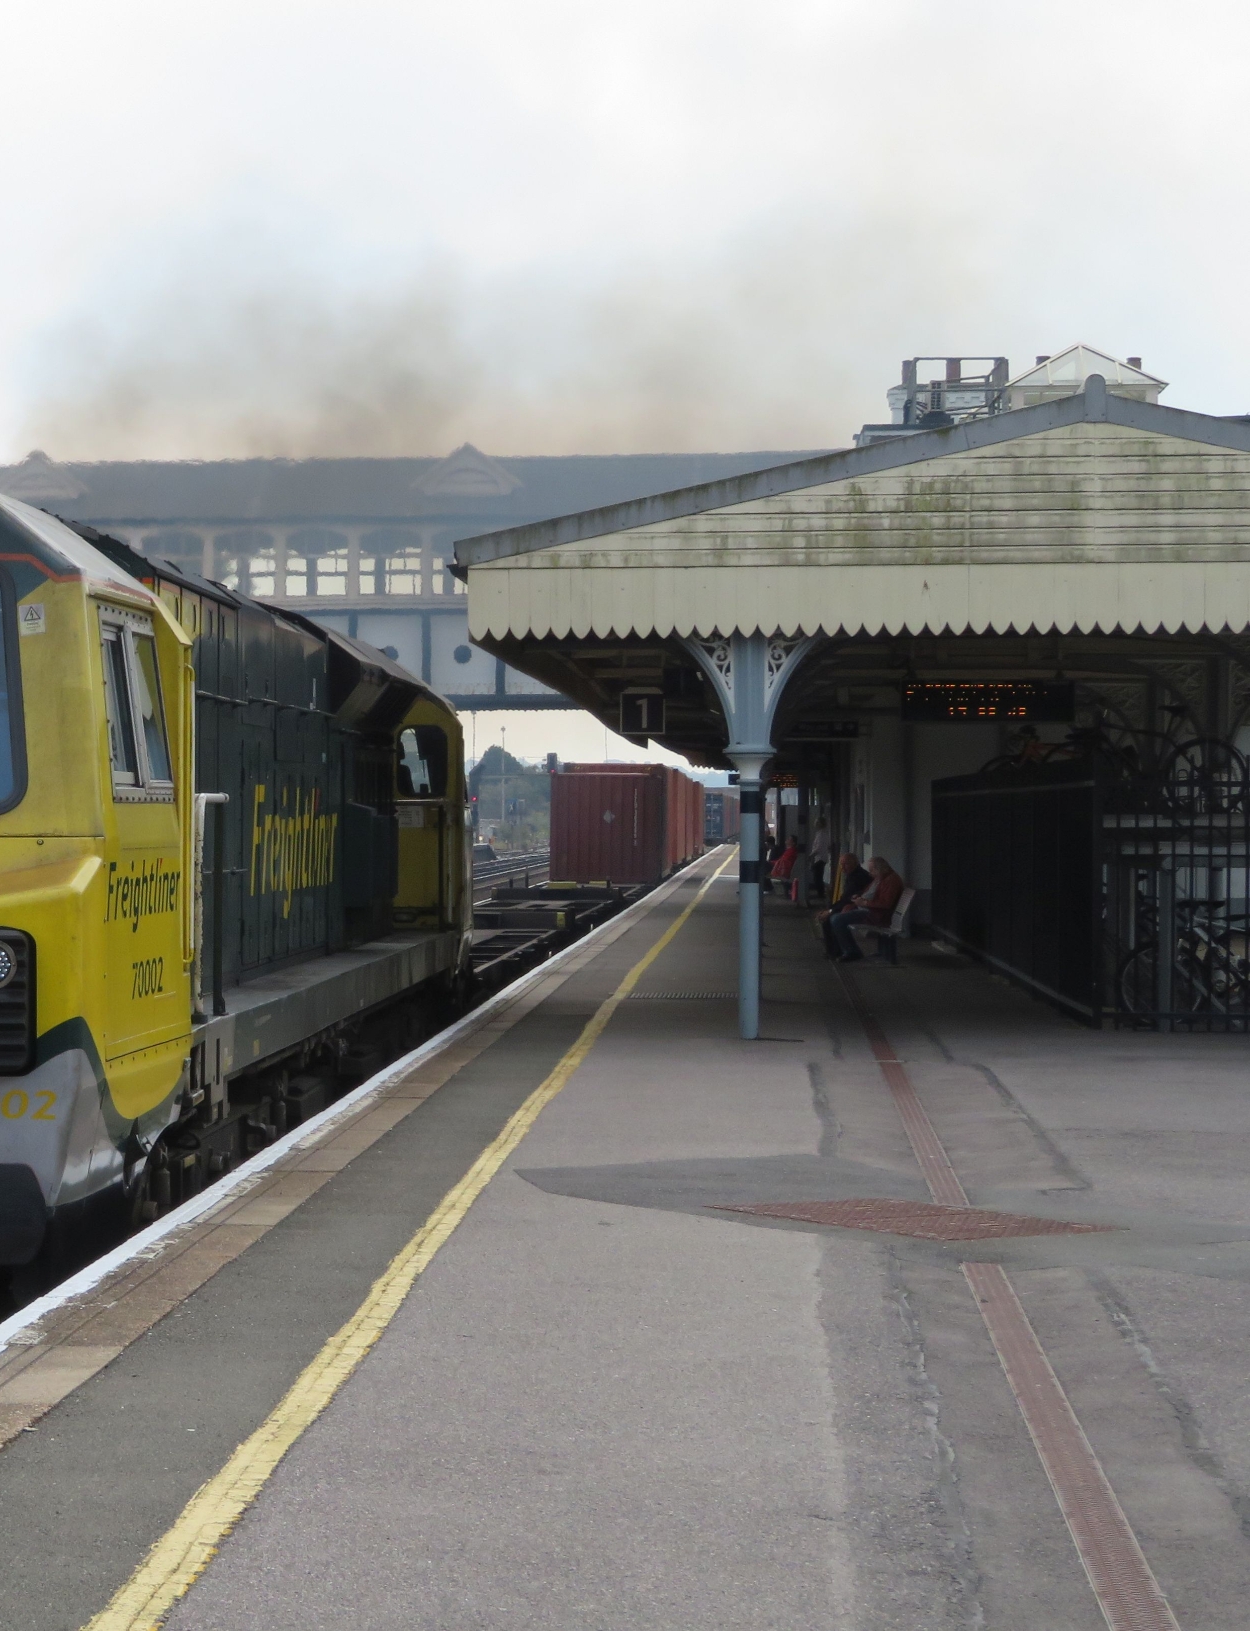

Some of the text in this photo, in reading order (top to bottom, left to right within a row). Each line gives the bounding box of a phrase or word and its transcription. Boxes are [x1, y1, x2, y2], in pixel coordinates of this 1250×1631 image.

[636, 698, 647, 728] 1
[250, 784, 338, 919] Freightliner
[107, 859, 181, 932] Freightliner
[132, 957, 164, 999] 70002
